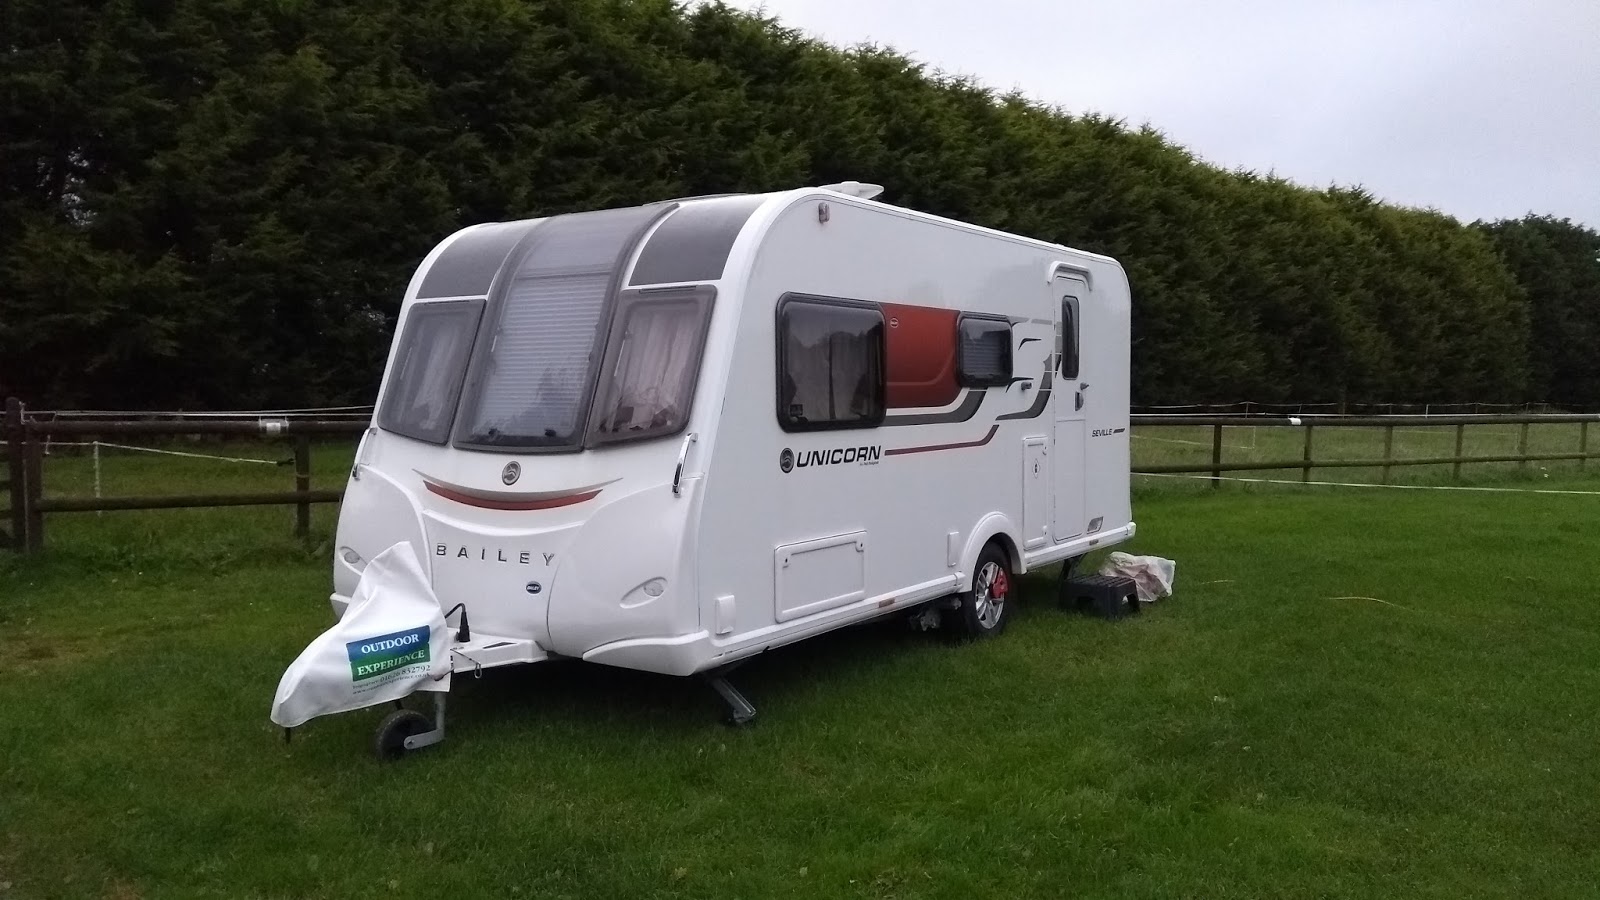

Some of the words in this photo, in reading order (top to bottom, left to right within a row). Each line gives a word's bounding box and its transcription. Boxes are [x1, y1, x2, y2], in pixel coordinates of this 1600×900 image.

[1091, 428, 1112, 437] SEVILLE
[796, 445, 881, 467] UNICORN
[436, 543, 555, 566] BAILEY
[361, 633, 419, 654] OUTDOOR
[357, 649, 425, 676] EXPERIENCE
